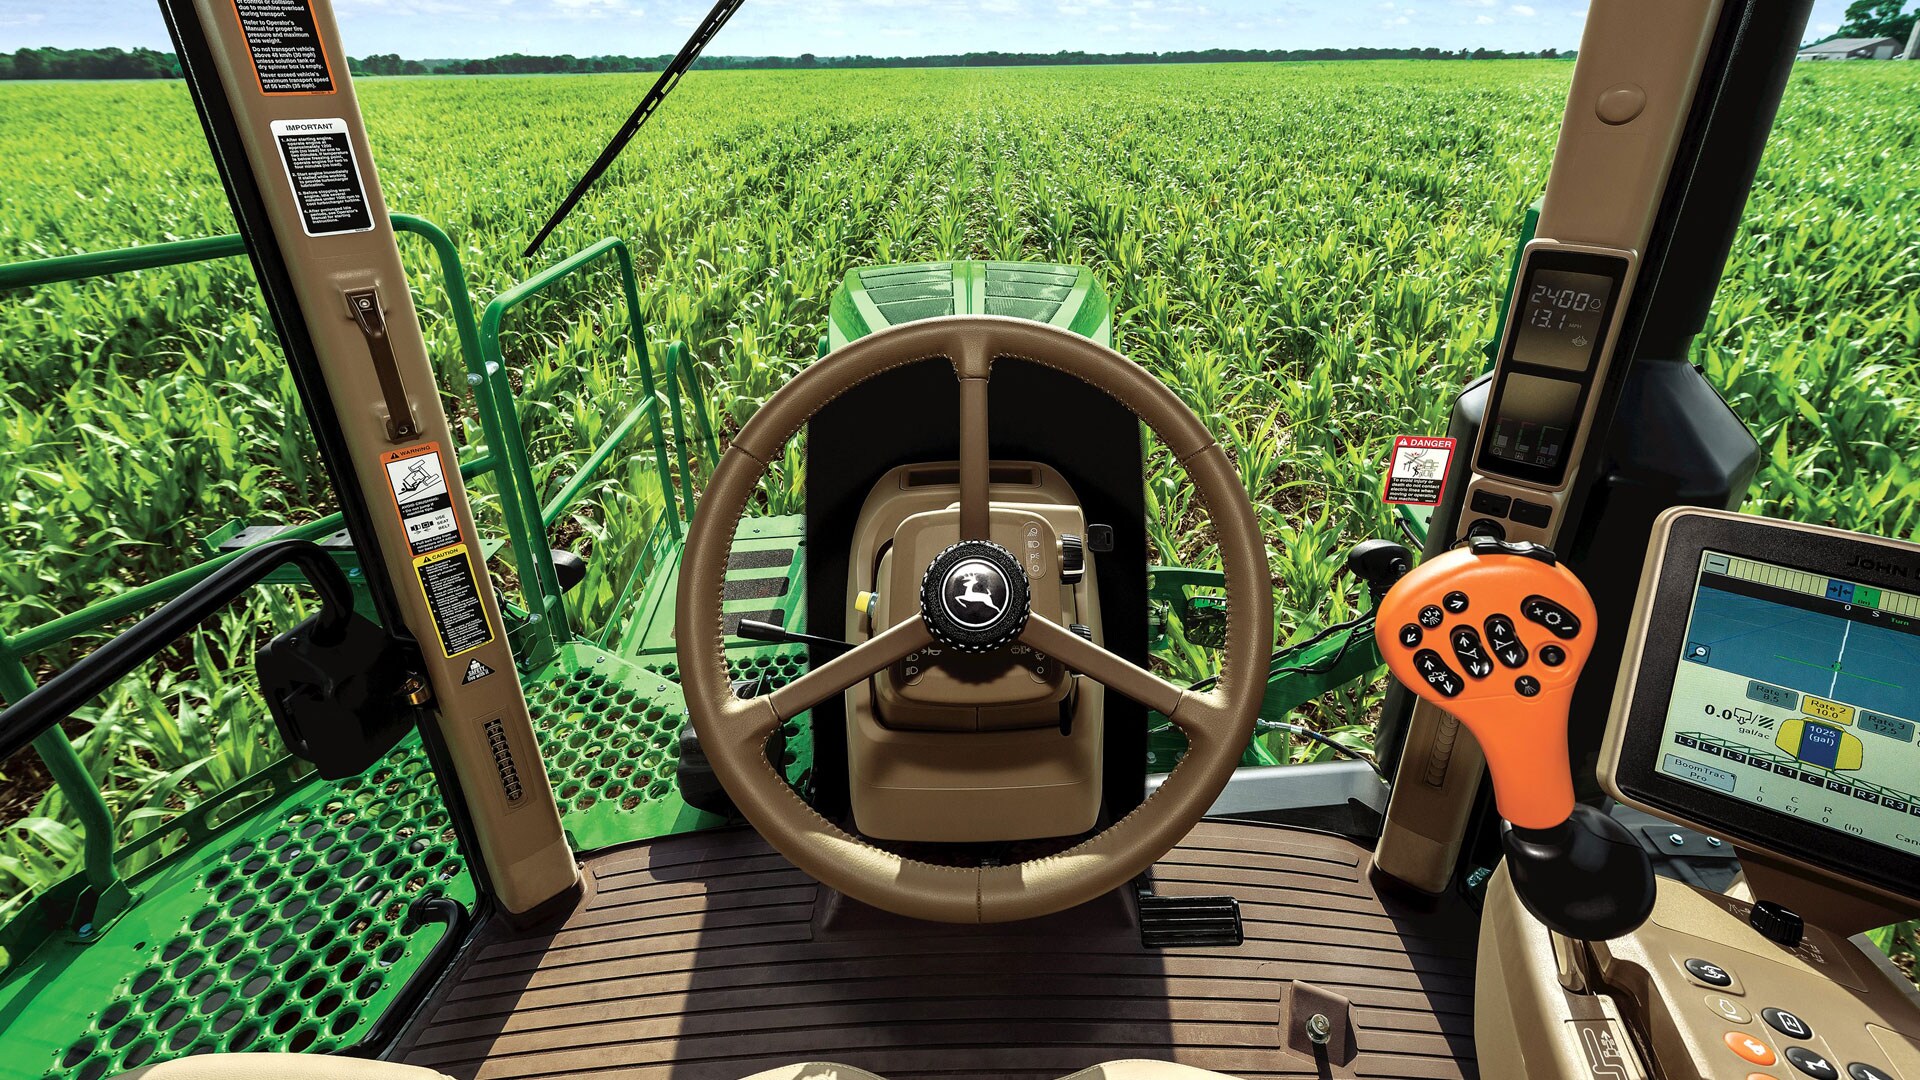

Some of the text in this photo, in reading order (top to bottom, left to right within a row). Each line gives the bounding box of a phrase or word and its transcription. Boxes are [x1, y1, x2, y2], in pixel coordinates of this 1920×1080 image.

[286, 123, 333, 131] IMPORTANT
[1532, 285, 1590, 312] 2400
[1531, 309, 1566, 330] 13.1
[1410, 440, 1452, 448] DANGER
[400, 446, 430, 456] WARNING
[432, 548, 458, 560] CAUTION
[1846, 556, 1910, 577] JOHN
[1890, 618, 1910, 626] Turn
[468, 666, 485, 676] SAFETY
[1756, 685, 1780, 696] Rate
[1763, 694, 1779, 702] 8.5
[1810, 700, 1836, 712] Rate
[1704, 704, 1732, 720] 0.0
[1816, 708, 1838, 719] 10.0
[1868, 715, 1894, 727] Rate
[1738, 727, 1770, 740] gal/ac
[1810, 726, 1836, 737] 1025
[1874, 724, 1897, 735] 12.5
[1809, 733, 1834, 747] (gal)
[1674, 758, 1726, 780] BoomTrac
[1690, 771, 1707, 782] Pro
[1785, 805, 1799, 814] 67
[1824, 806, 1833, 814] R
[1844, 823, 1863, 836] (in)
[1895, 834, 1920, 846] Can
